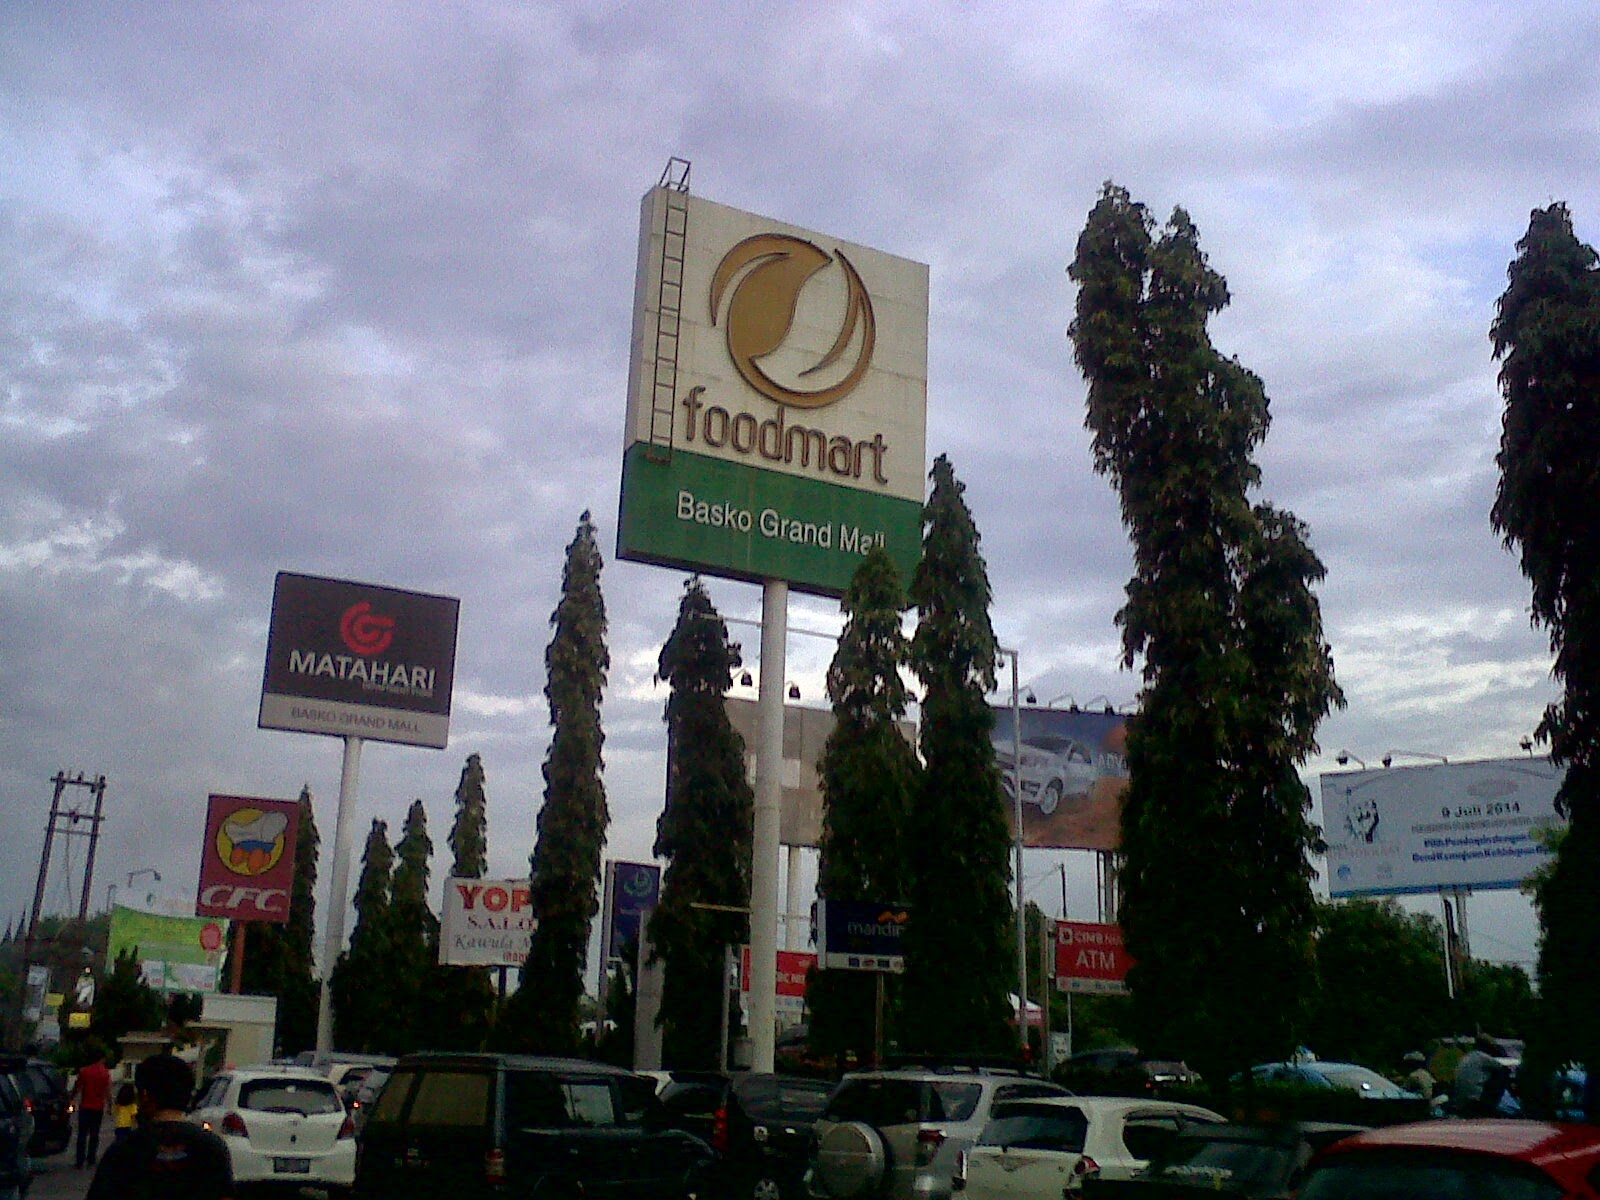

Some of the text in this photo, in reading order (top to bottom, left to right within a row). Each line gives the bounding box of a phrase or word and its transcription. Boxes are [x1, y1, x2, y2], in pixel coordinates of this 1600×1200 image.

[682, 386, 888, 484] foodmart
[676, 490, 752, 533] Basko
[759, 508, 832, 549] Grand
[289, 649, 437, 691] MATAHARI
[200, 883, 287, 913] CFC
[847, 920, 906, 938] mandir
[1075, 949, 1115, 970] ATM
